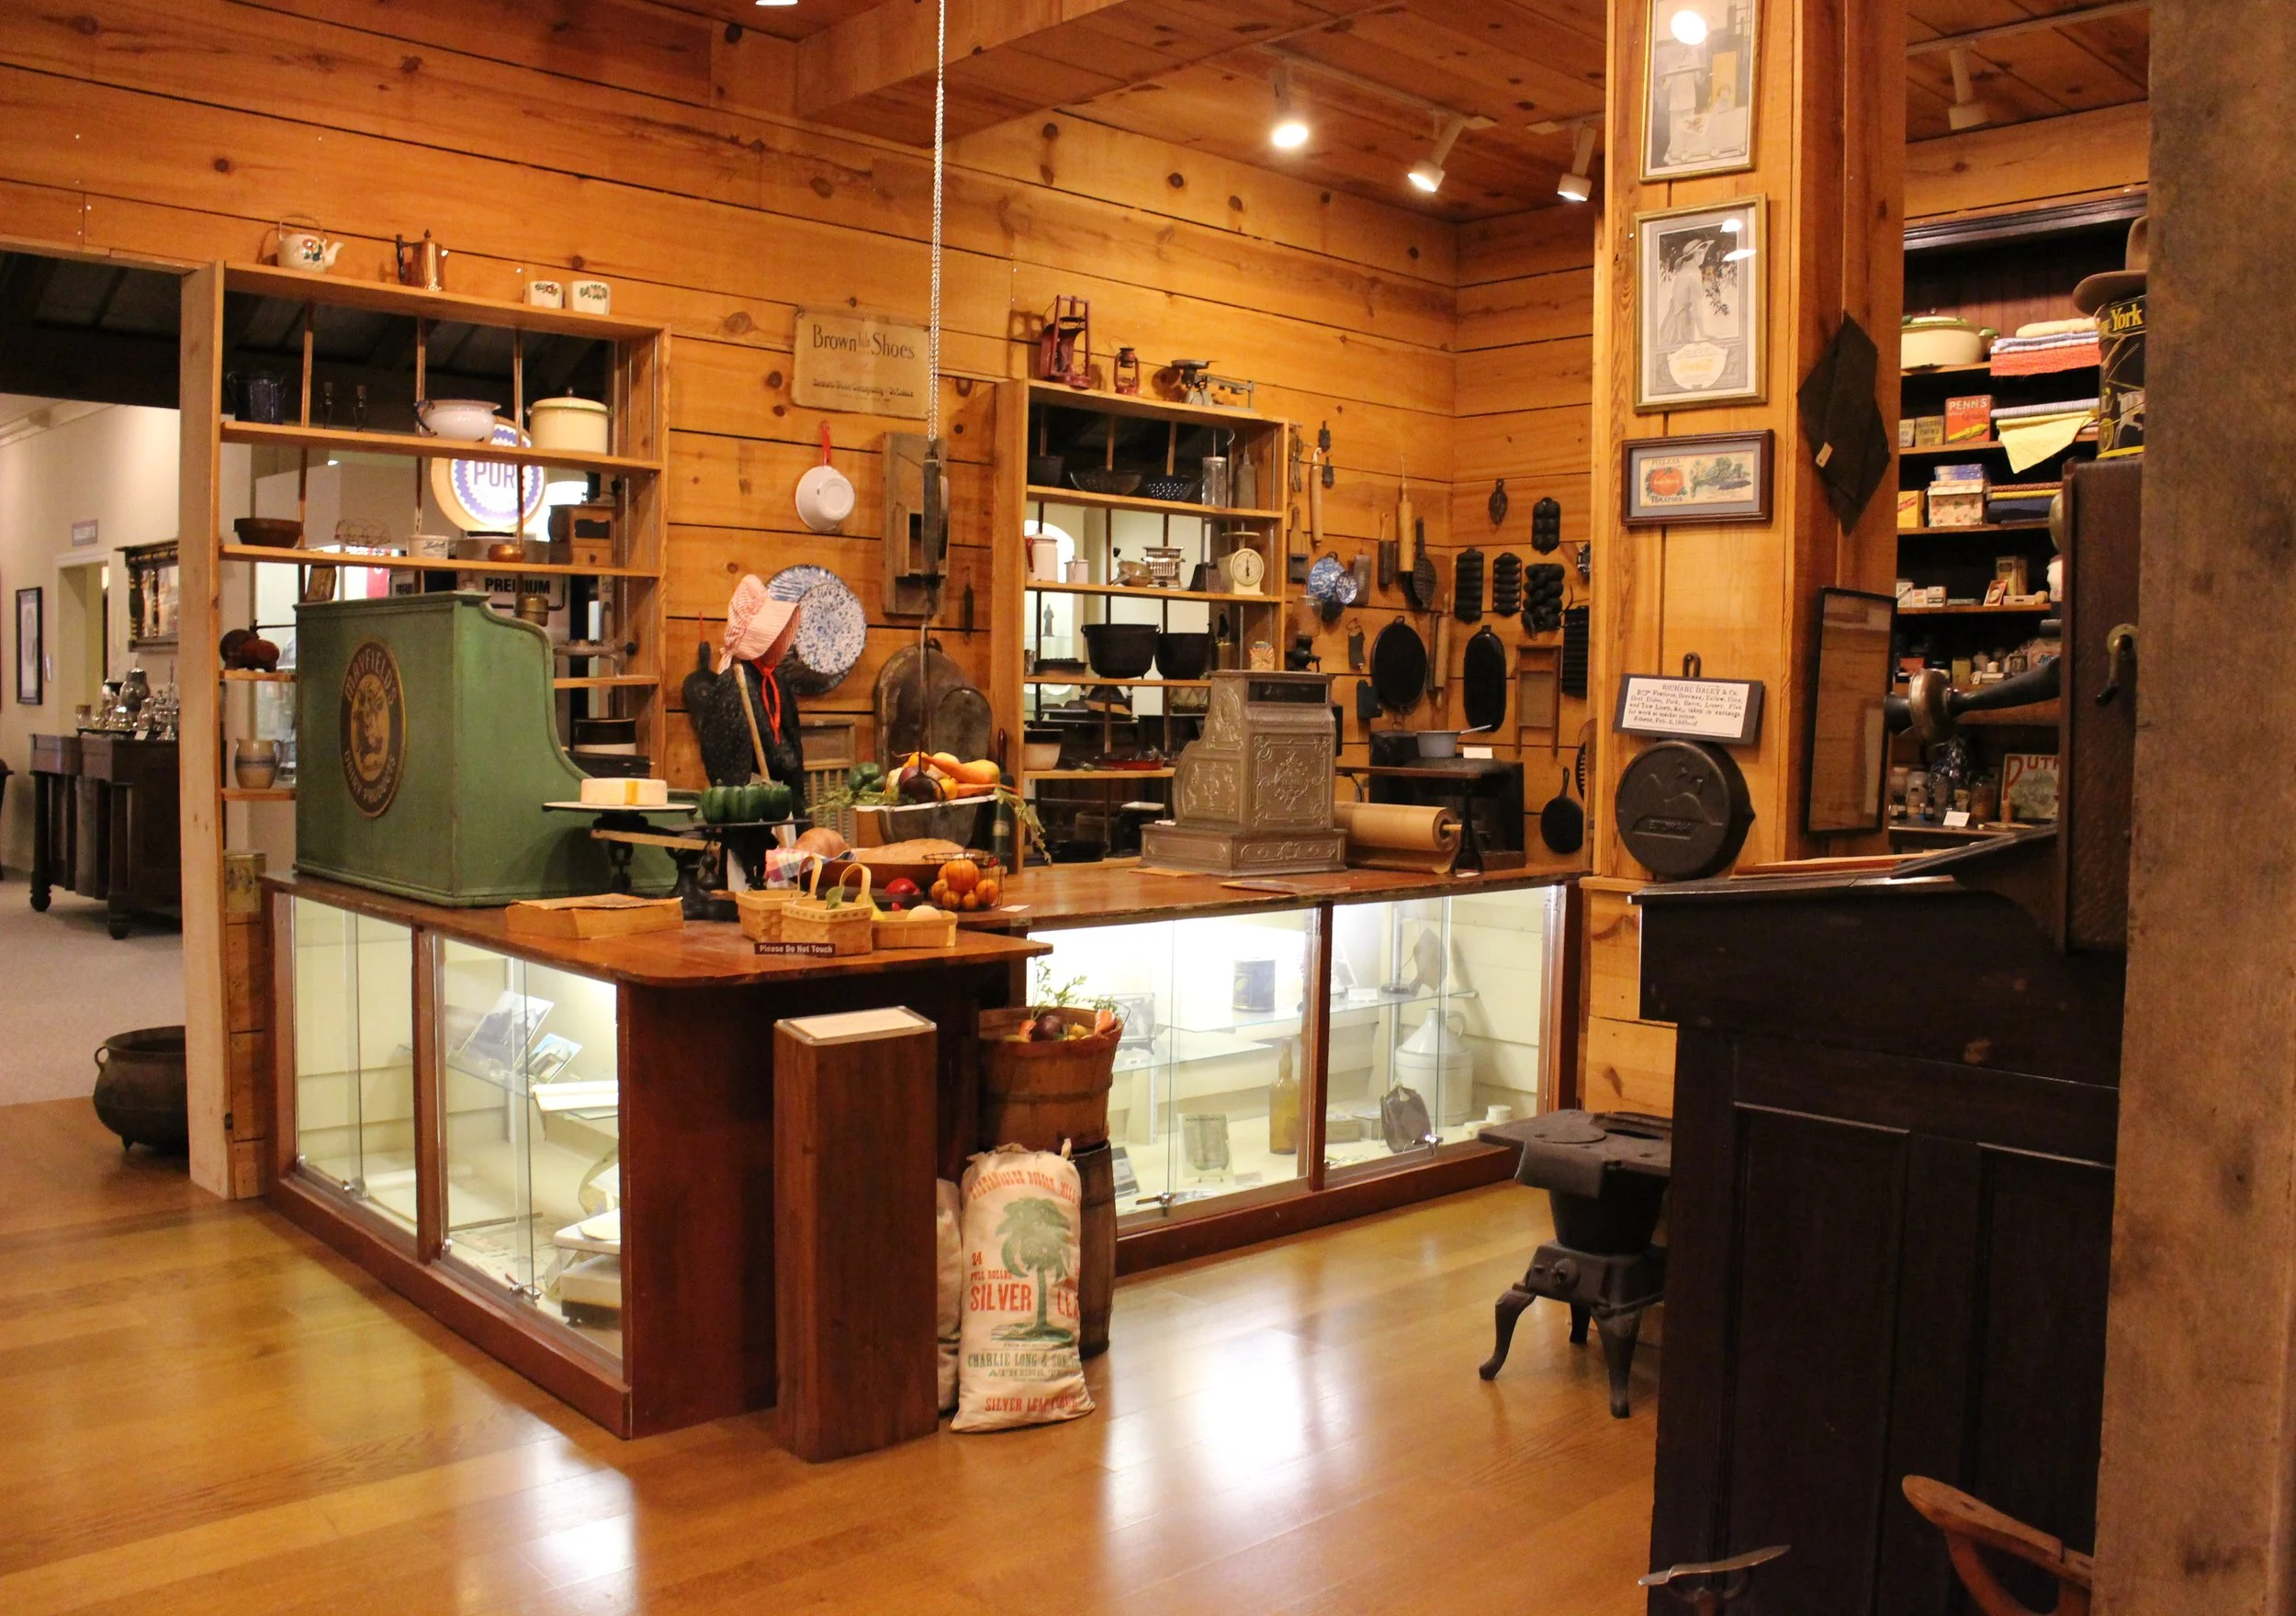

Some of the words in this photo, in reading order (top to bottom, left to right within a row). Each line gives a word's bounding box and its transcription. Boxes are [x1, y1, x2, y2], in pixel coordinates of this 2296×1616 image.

[2110, 304, 2144, 331] York
[872, 332, 915, 360] Shoes
[1715, 710, 1741, 719] exchange
[759, 945, 784, 953] Please
[785, 945, 796, 953] Do
[797, 945, 810, 953] Not
[811, 945, 833, 954] Touch
[970, 1283, 1032, 1313] SILVER
[1055, 1289, 1080, 1320] LEA
[967, 1352, 1011, 1369] CHARLIE
[1014, 1352, 1038, 1368] LONG
[1041, 1353, 1049, 1368] &
[985, 1396, 1022, 1412] SILVER
